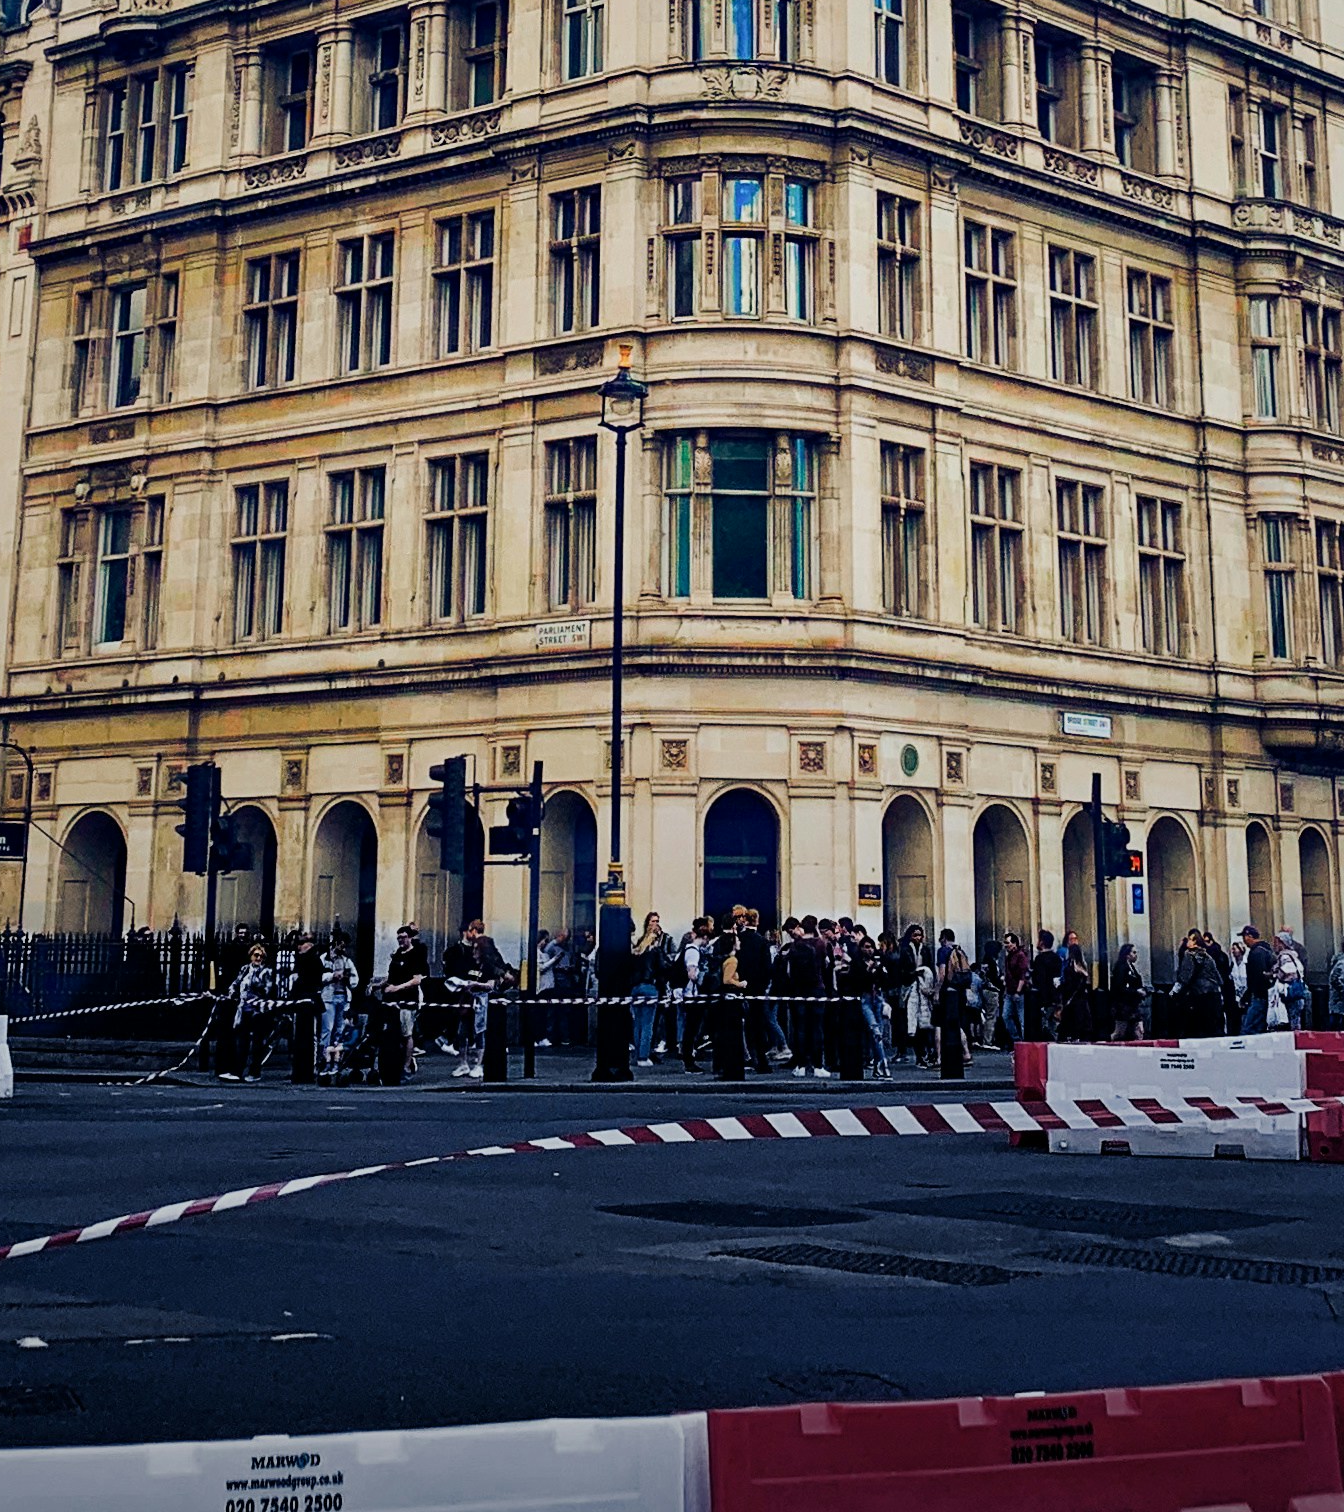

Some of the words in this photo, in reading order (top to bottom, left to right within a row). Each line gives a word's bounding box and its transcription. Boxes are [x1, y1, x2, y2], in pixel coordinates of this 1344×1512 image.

[539, 624, 586, 635] PARLIAMENT
[539, 635, 567, 645] STREET
[226, 1470, 344, 1491] www.marwoodgroup.co.uk
[225, 1498, 256, 1512] 020
[259, 1495, 299, 1512] 7540
[304, 1492, 343, 1512] 2500
